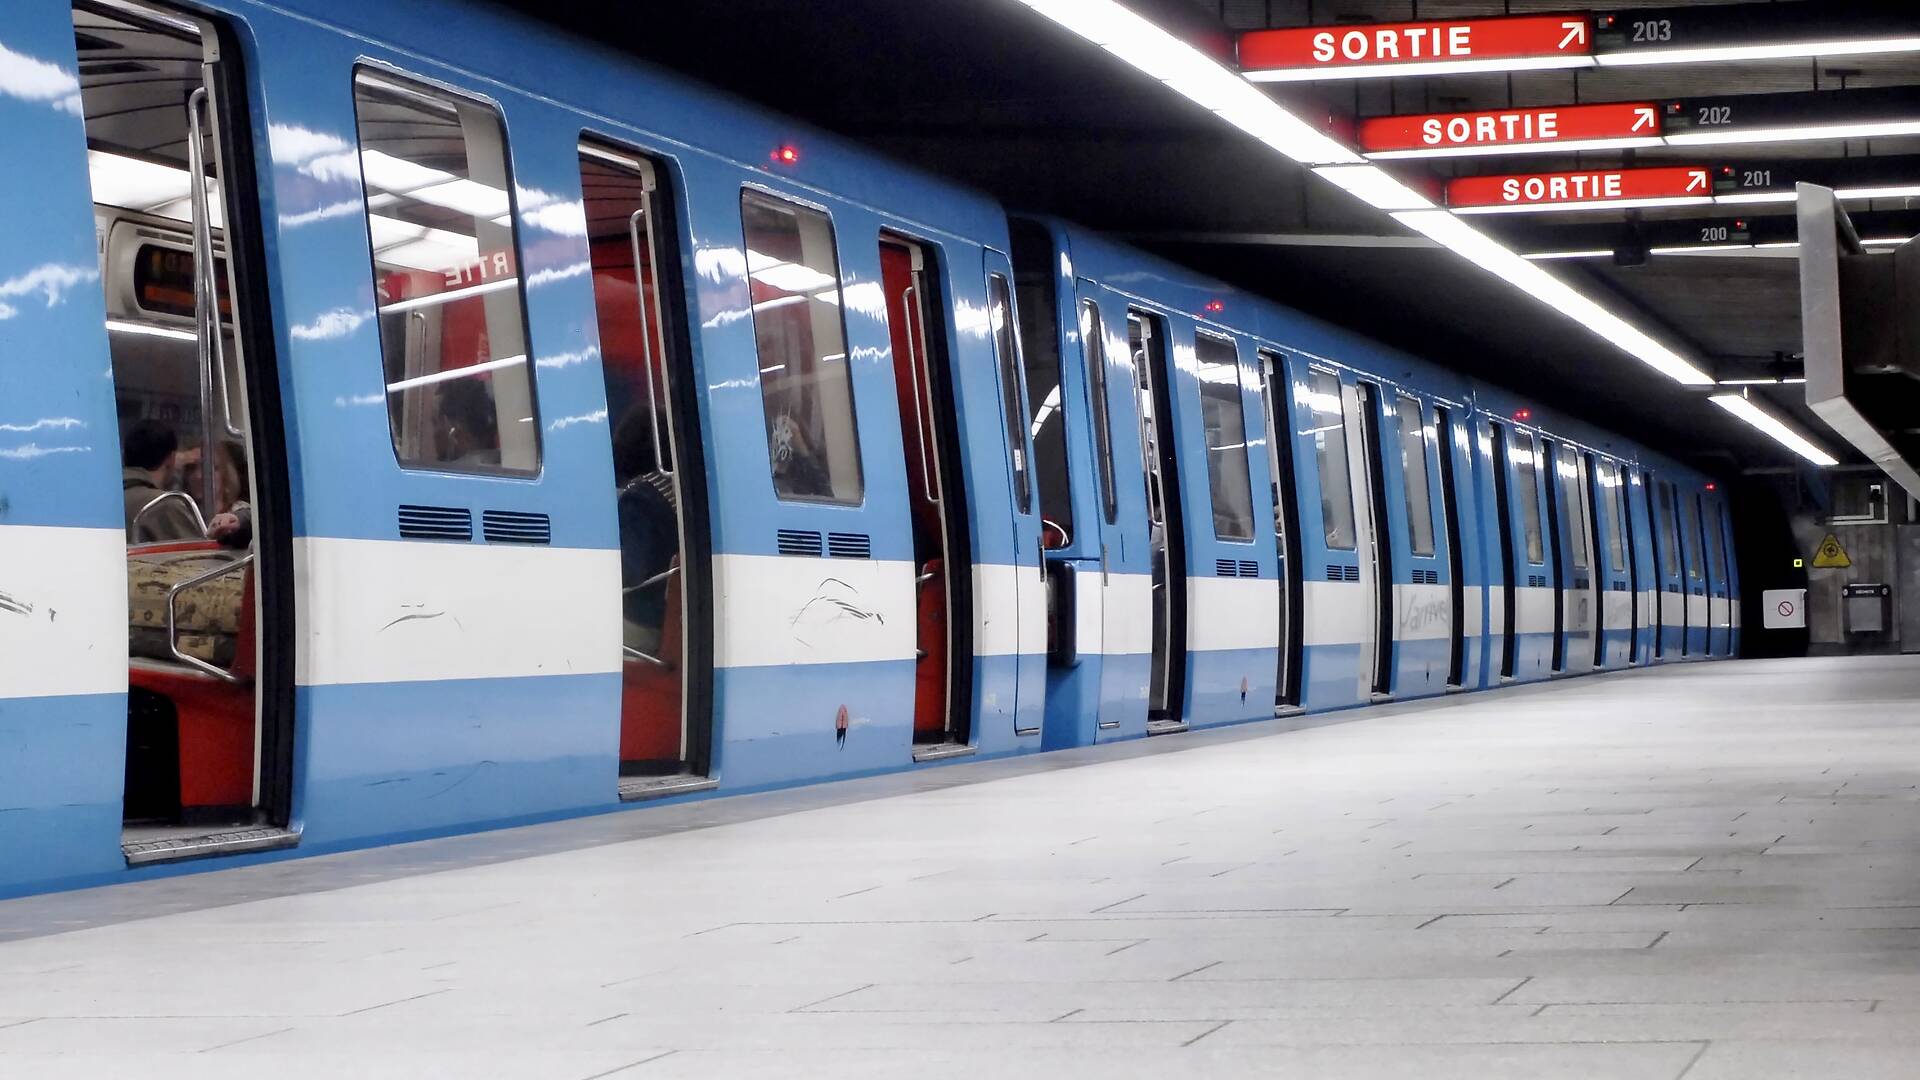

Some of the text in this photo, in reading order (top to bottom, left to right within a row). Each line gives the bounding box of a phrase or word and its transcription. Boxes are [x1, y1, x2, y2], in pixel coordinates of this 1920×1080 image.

[1632, 20, 1672, 42] 203
[1312, 26, 1472, 62] SORTIE
[1699, 106, 1732, 125] 202
[1422, 112, 1558, 145] SORTIE
[1502, 174, 1622, 201] SORTIE
[1743, 170, 1771, 187] 201
[1701, 226, 1727, 242] 200
